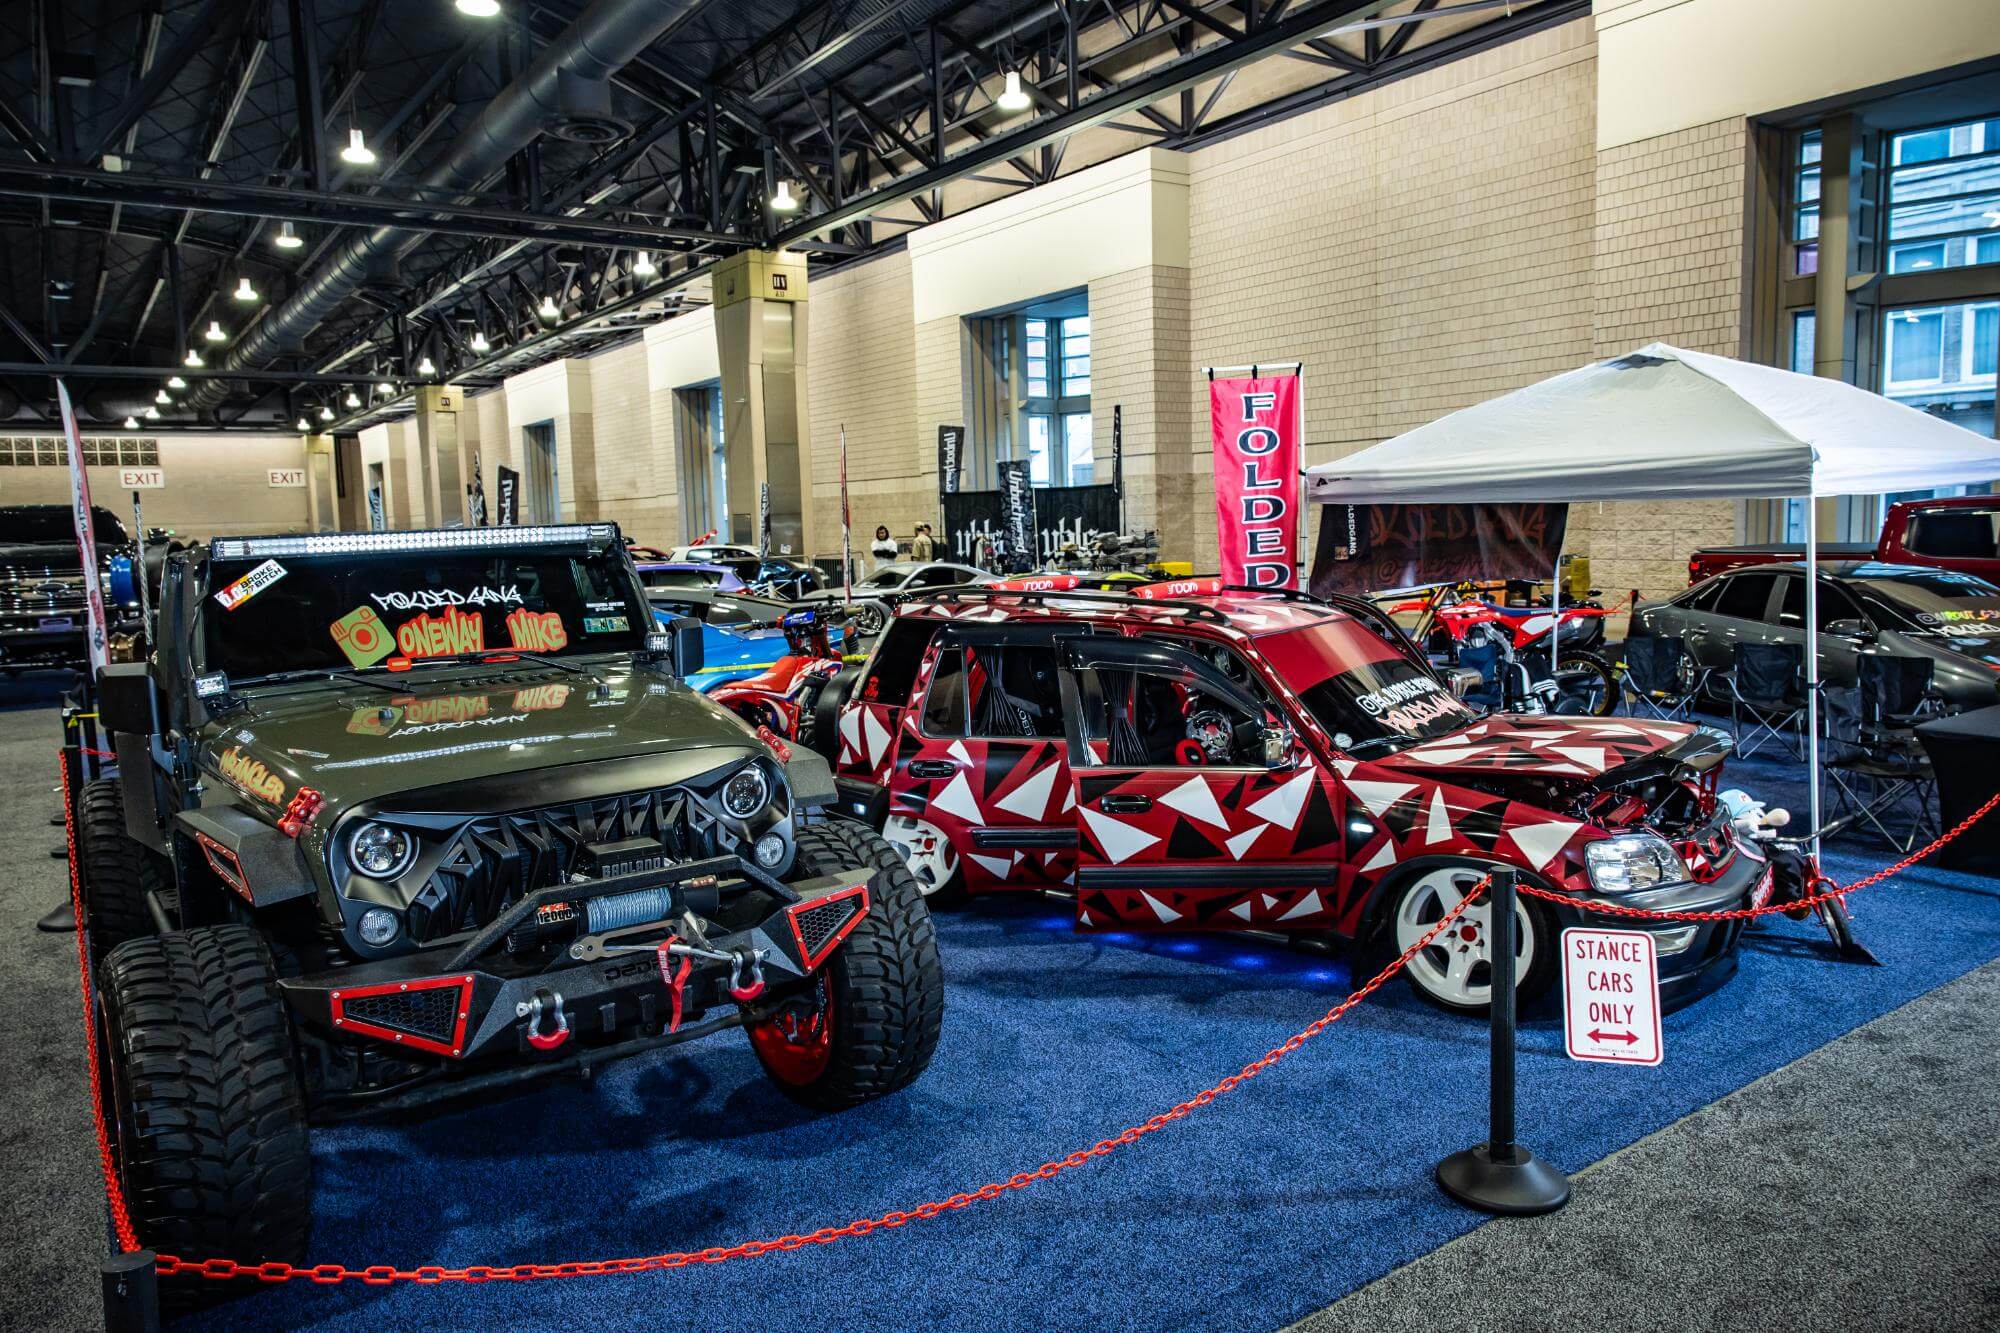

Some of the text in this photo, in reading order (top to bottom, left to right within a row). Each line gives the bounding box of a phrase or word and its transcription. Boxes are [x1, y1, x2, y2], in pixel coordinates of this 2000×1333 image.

[124, 472, 160, 485] EXIT
[270, 472, 303, 484] EXIT
[1237, 391, 1291, 588] FOLDED
[240, 565, 274, 589] BROKE
[254, 567, 283, 588] BITCH
[398, 606, 566, 657] ONEWAY MIKE
[602, 856, 661, 878] BADLAND
[1576, 939, 1642, 963] STANCE
[1587, 971, 1634, 994] CARS
[1589, 1002, 1635, 1025] ONLY
